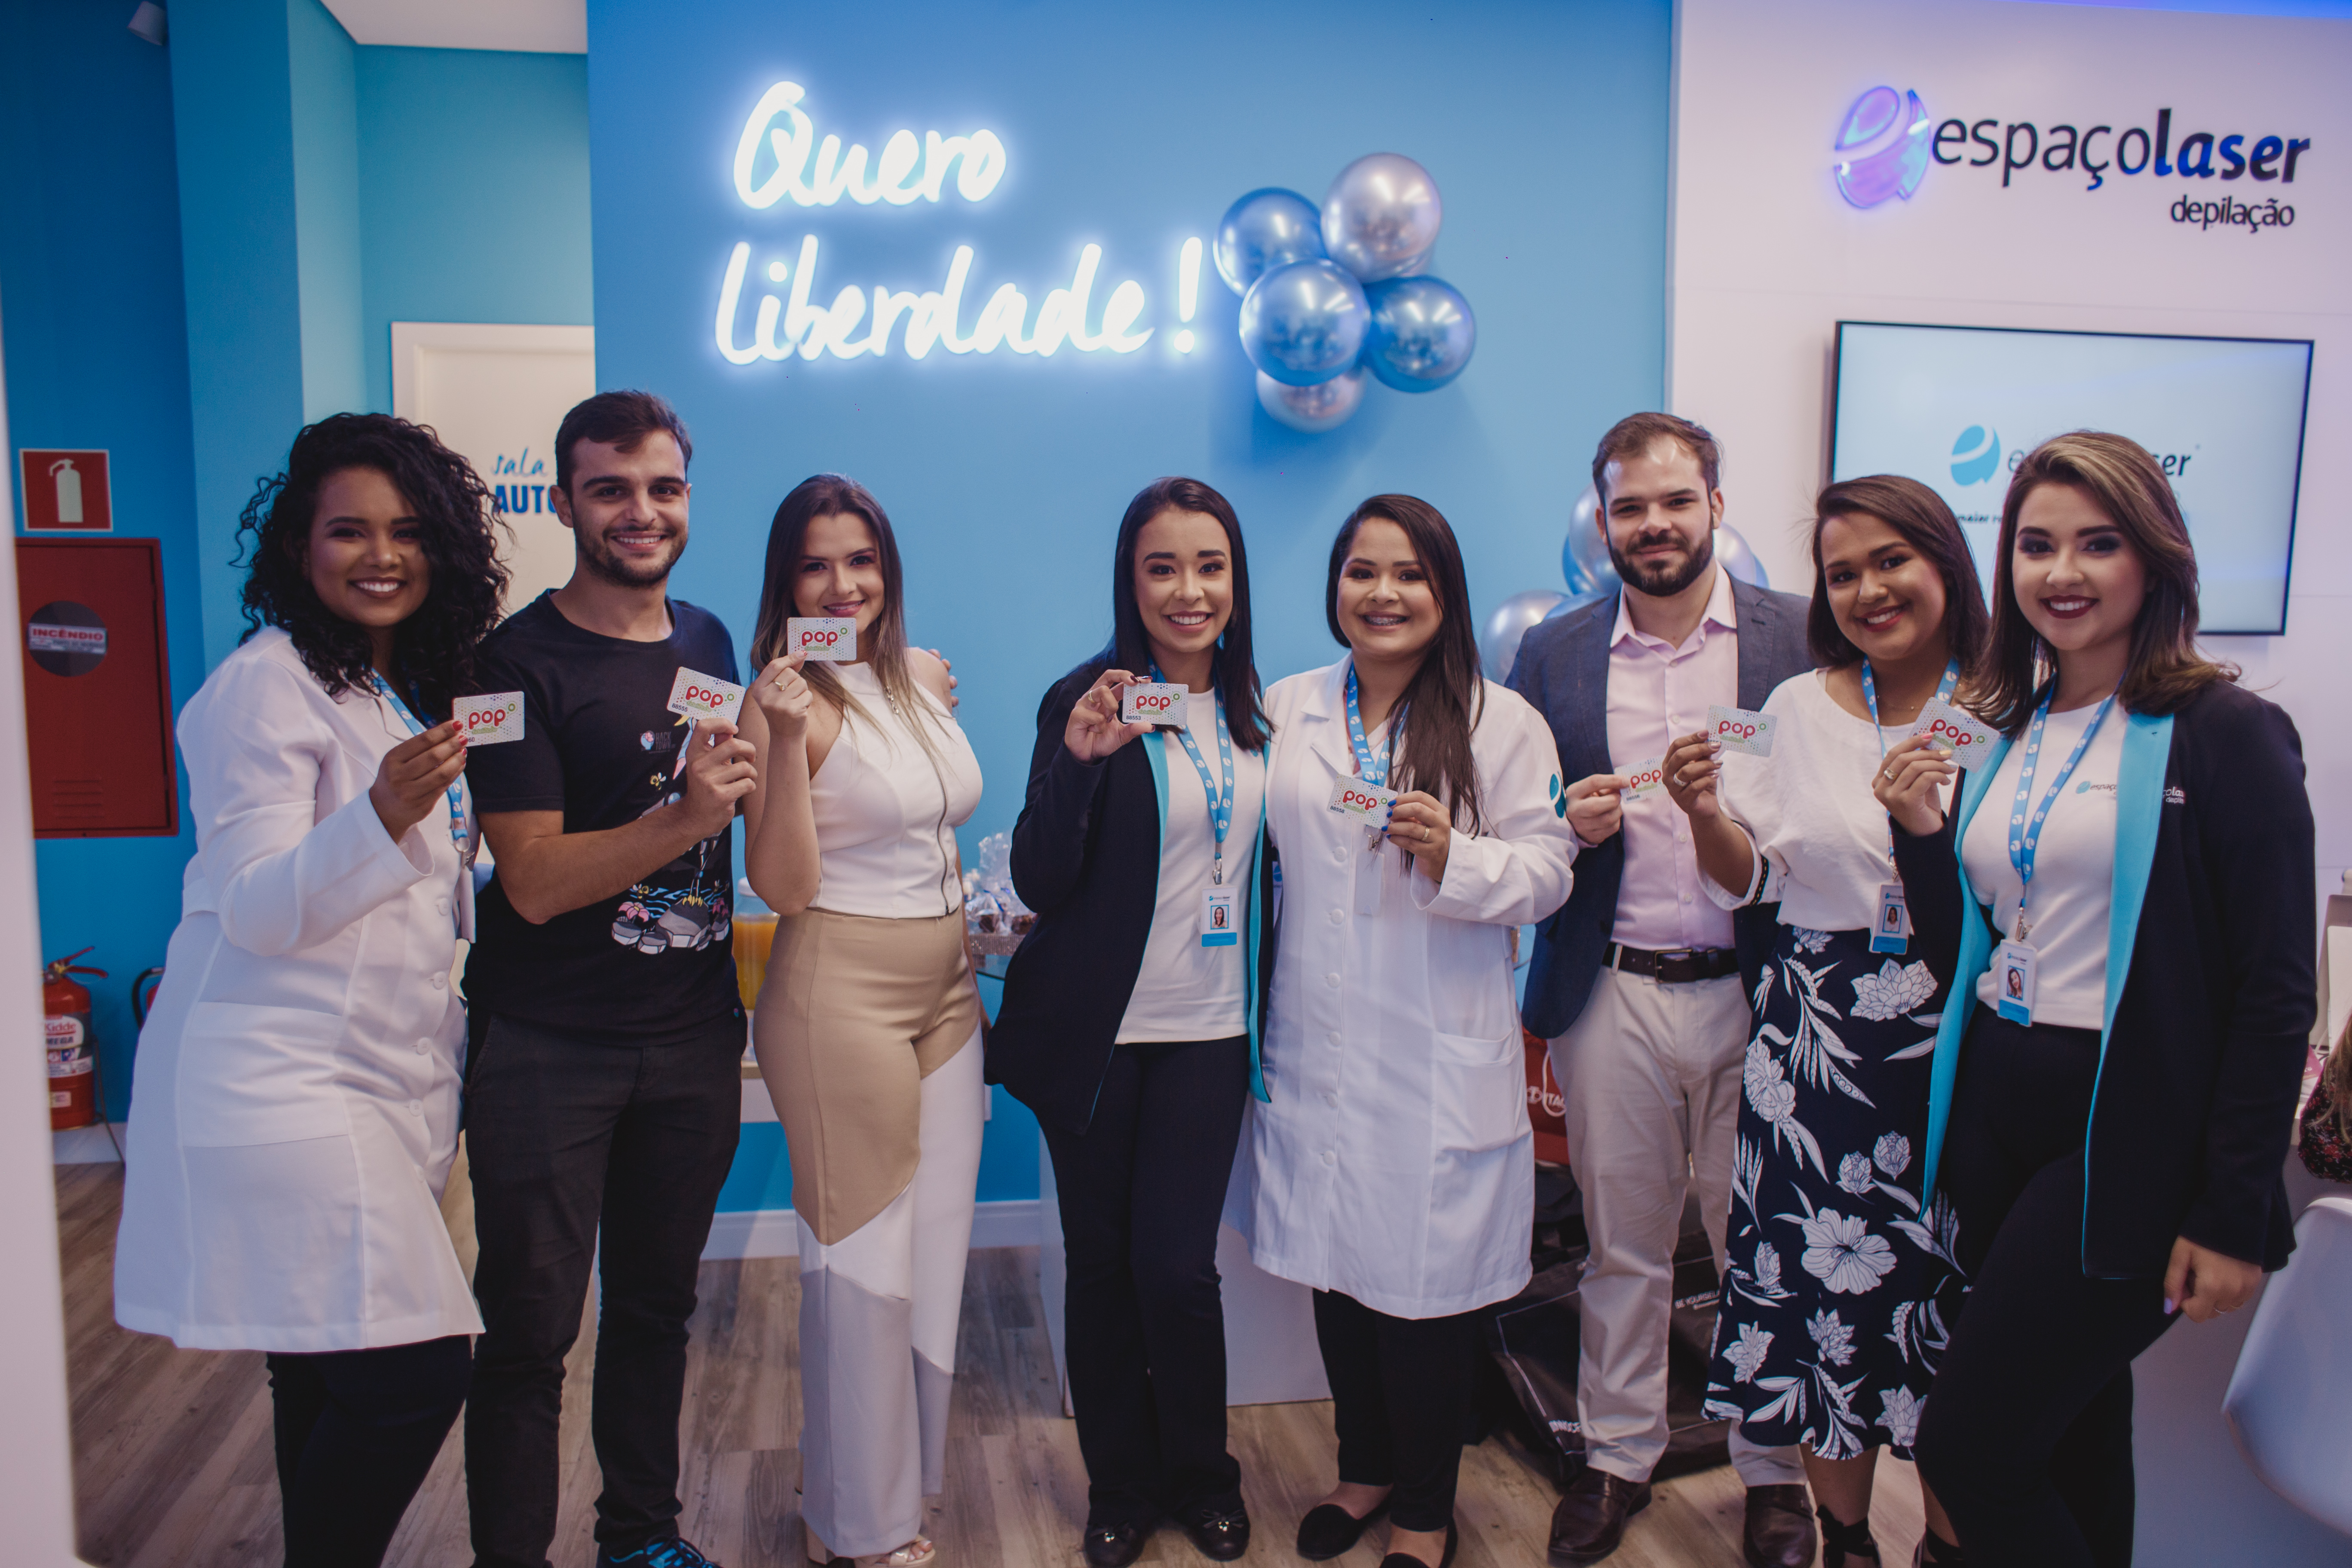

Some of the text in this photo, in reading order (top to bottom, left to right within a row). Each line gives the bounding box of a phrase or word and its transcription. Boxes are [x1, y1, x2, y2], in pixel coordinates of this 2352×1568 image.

[734, 81, 1006, 209] Quero
[1932, 108, 2311, 191] espaçolaser
[2171, 195, 2295, 233] depilação
[491, 446, 549, 477] sala
[33, 628, 104, 641] INCÊNDIO
[802, 631, 838, 646] pop
[672, 703, 688, 712] 88555
[686, 686, 723, 708] pop
[1136, 695, 1171, 711] pop
[469, 709, 506, 730] pop
[1718, 720, 1756, 739] pop
[1929, 719, 1972, 746] pop
[1630, 770, 1662, 789] pop
[1343, 790, 1378, 811] pop
